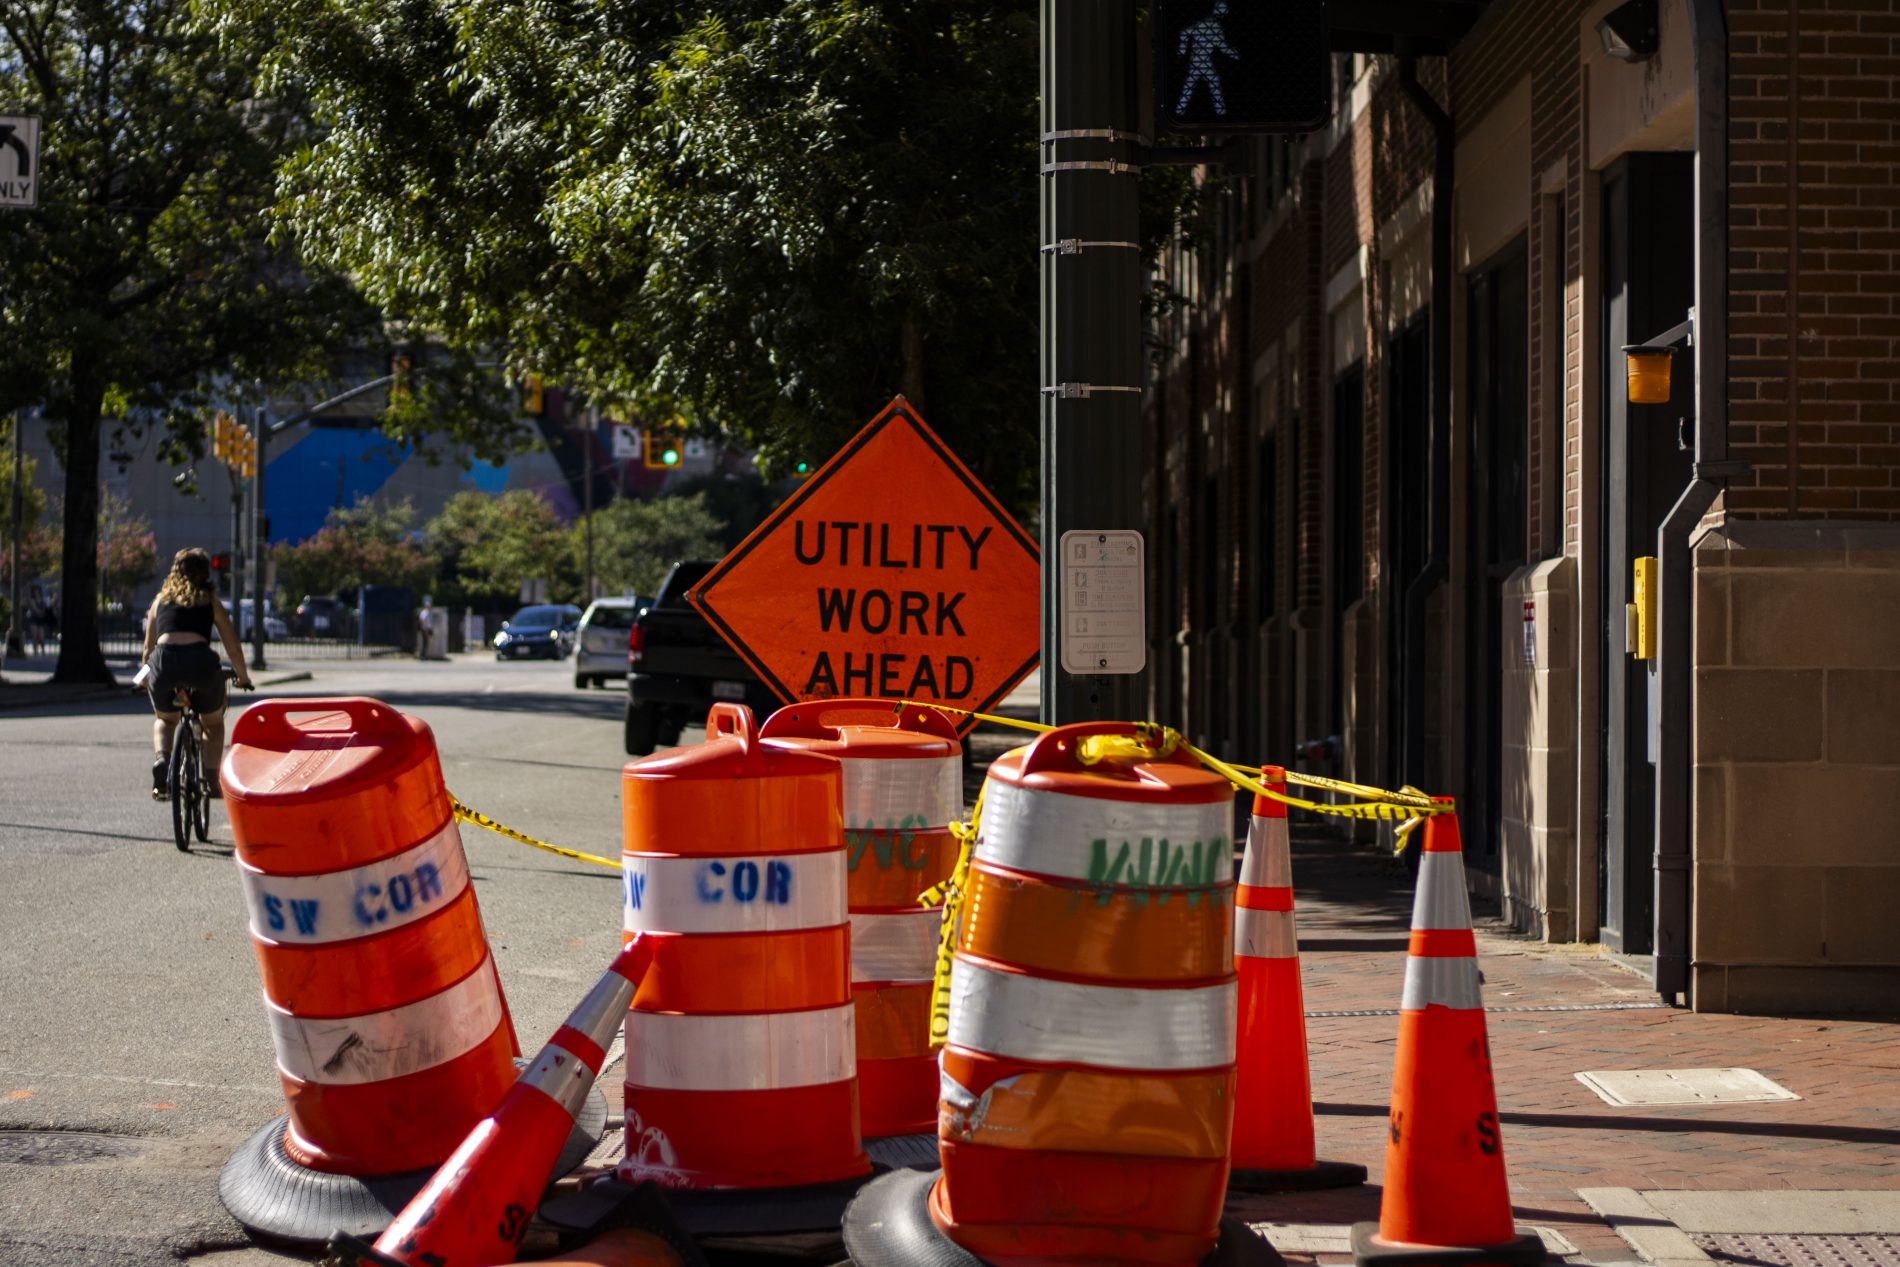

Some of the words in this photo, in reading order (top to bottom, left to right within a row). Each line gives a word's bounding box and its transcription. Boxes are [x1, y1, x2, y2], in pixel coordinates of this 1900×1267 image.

[0, 181, 31, 199] NLY
[794, 520, 993, 570] UTILITY
[817, 587, 967, 637] WORK
[805, 651, 974, 700] AHEAD
[262, 892, 319, 936] SW
[353, 862, 443, 928] COR
[695, 860, 792, 904] COR
